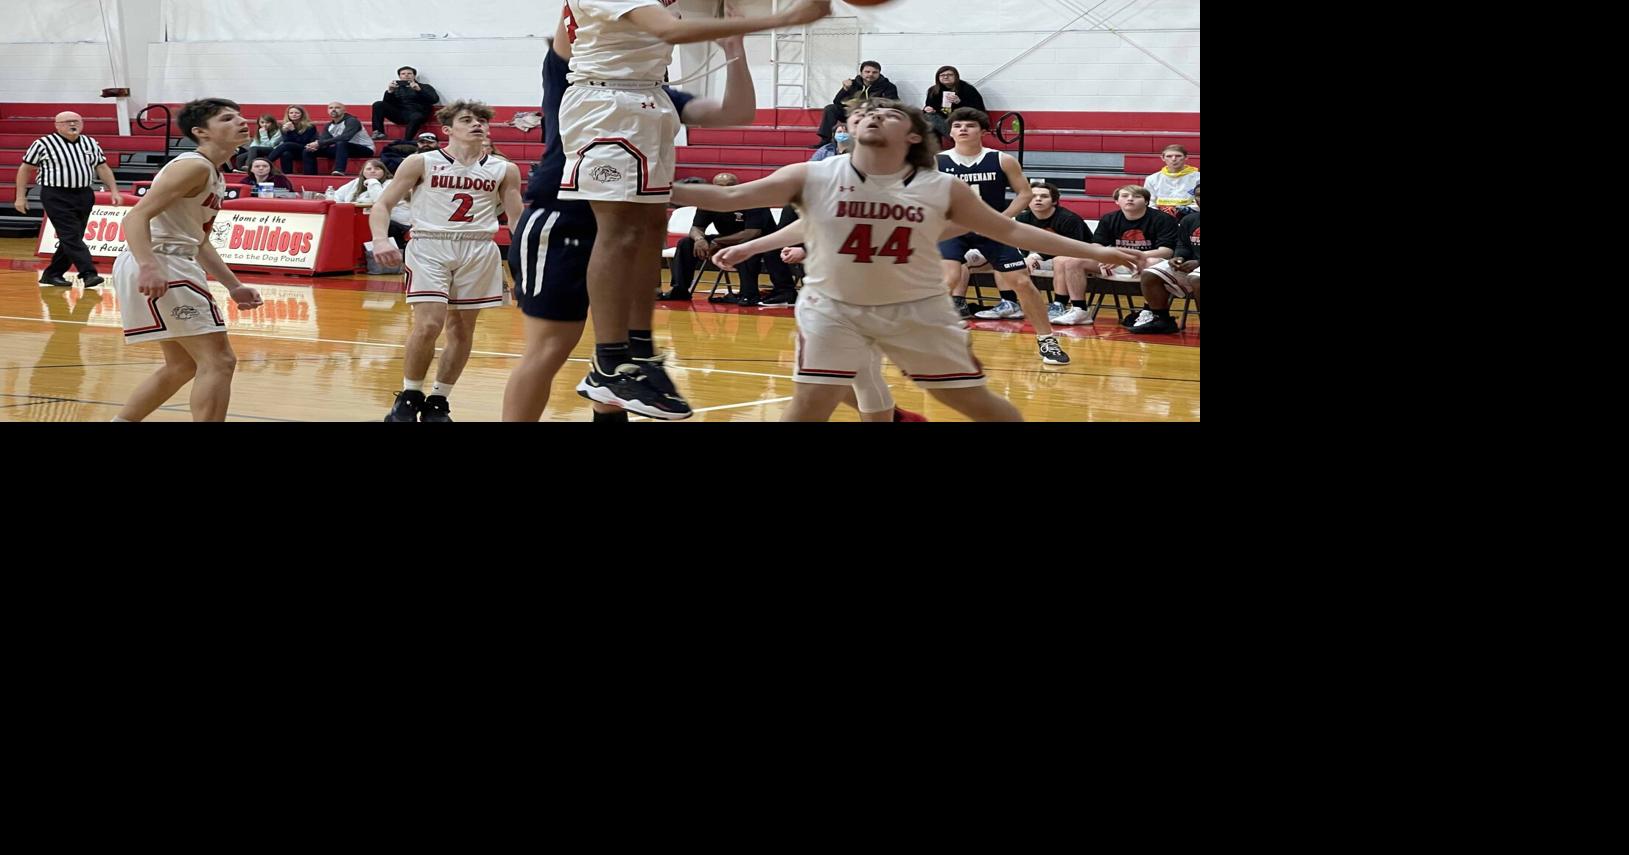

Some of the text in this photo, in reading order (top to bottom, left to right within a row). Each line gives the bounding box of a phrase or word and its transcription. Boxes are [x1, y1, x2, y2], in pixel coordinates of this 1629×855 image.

[431, 175, 496, 192] BULLDOGS
[960, 172, 996, 182] COVENANT
[91, 208, 120, 217] elcome
[448, 193, 474, 222] 2
[835, 201, 925, 223] BULLDOGS
[232, 214, 287, 224] Home of the
[229, 224, 313, 256] Bulldogs
[837, 223, 916, 264] 44
[99, 243, 128, 252] Acad
[262, 254, 278, 262] Dog
